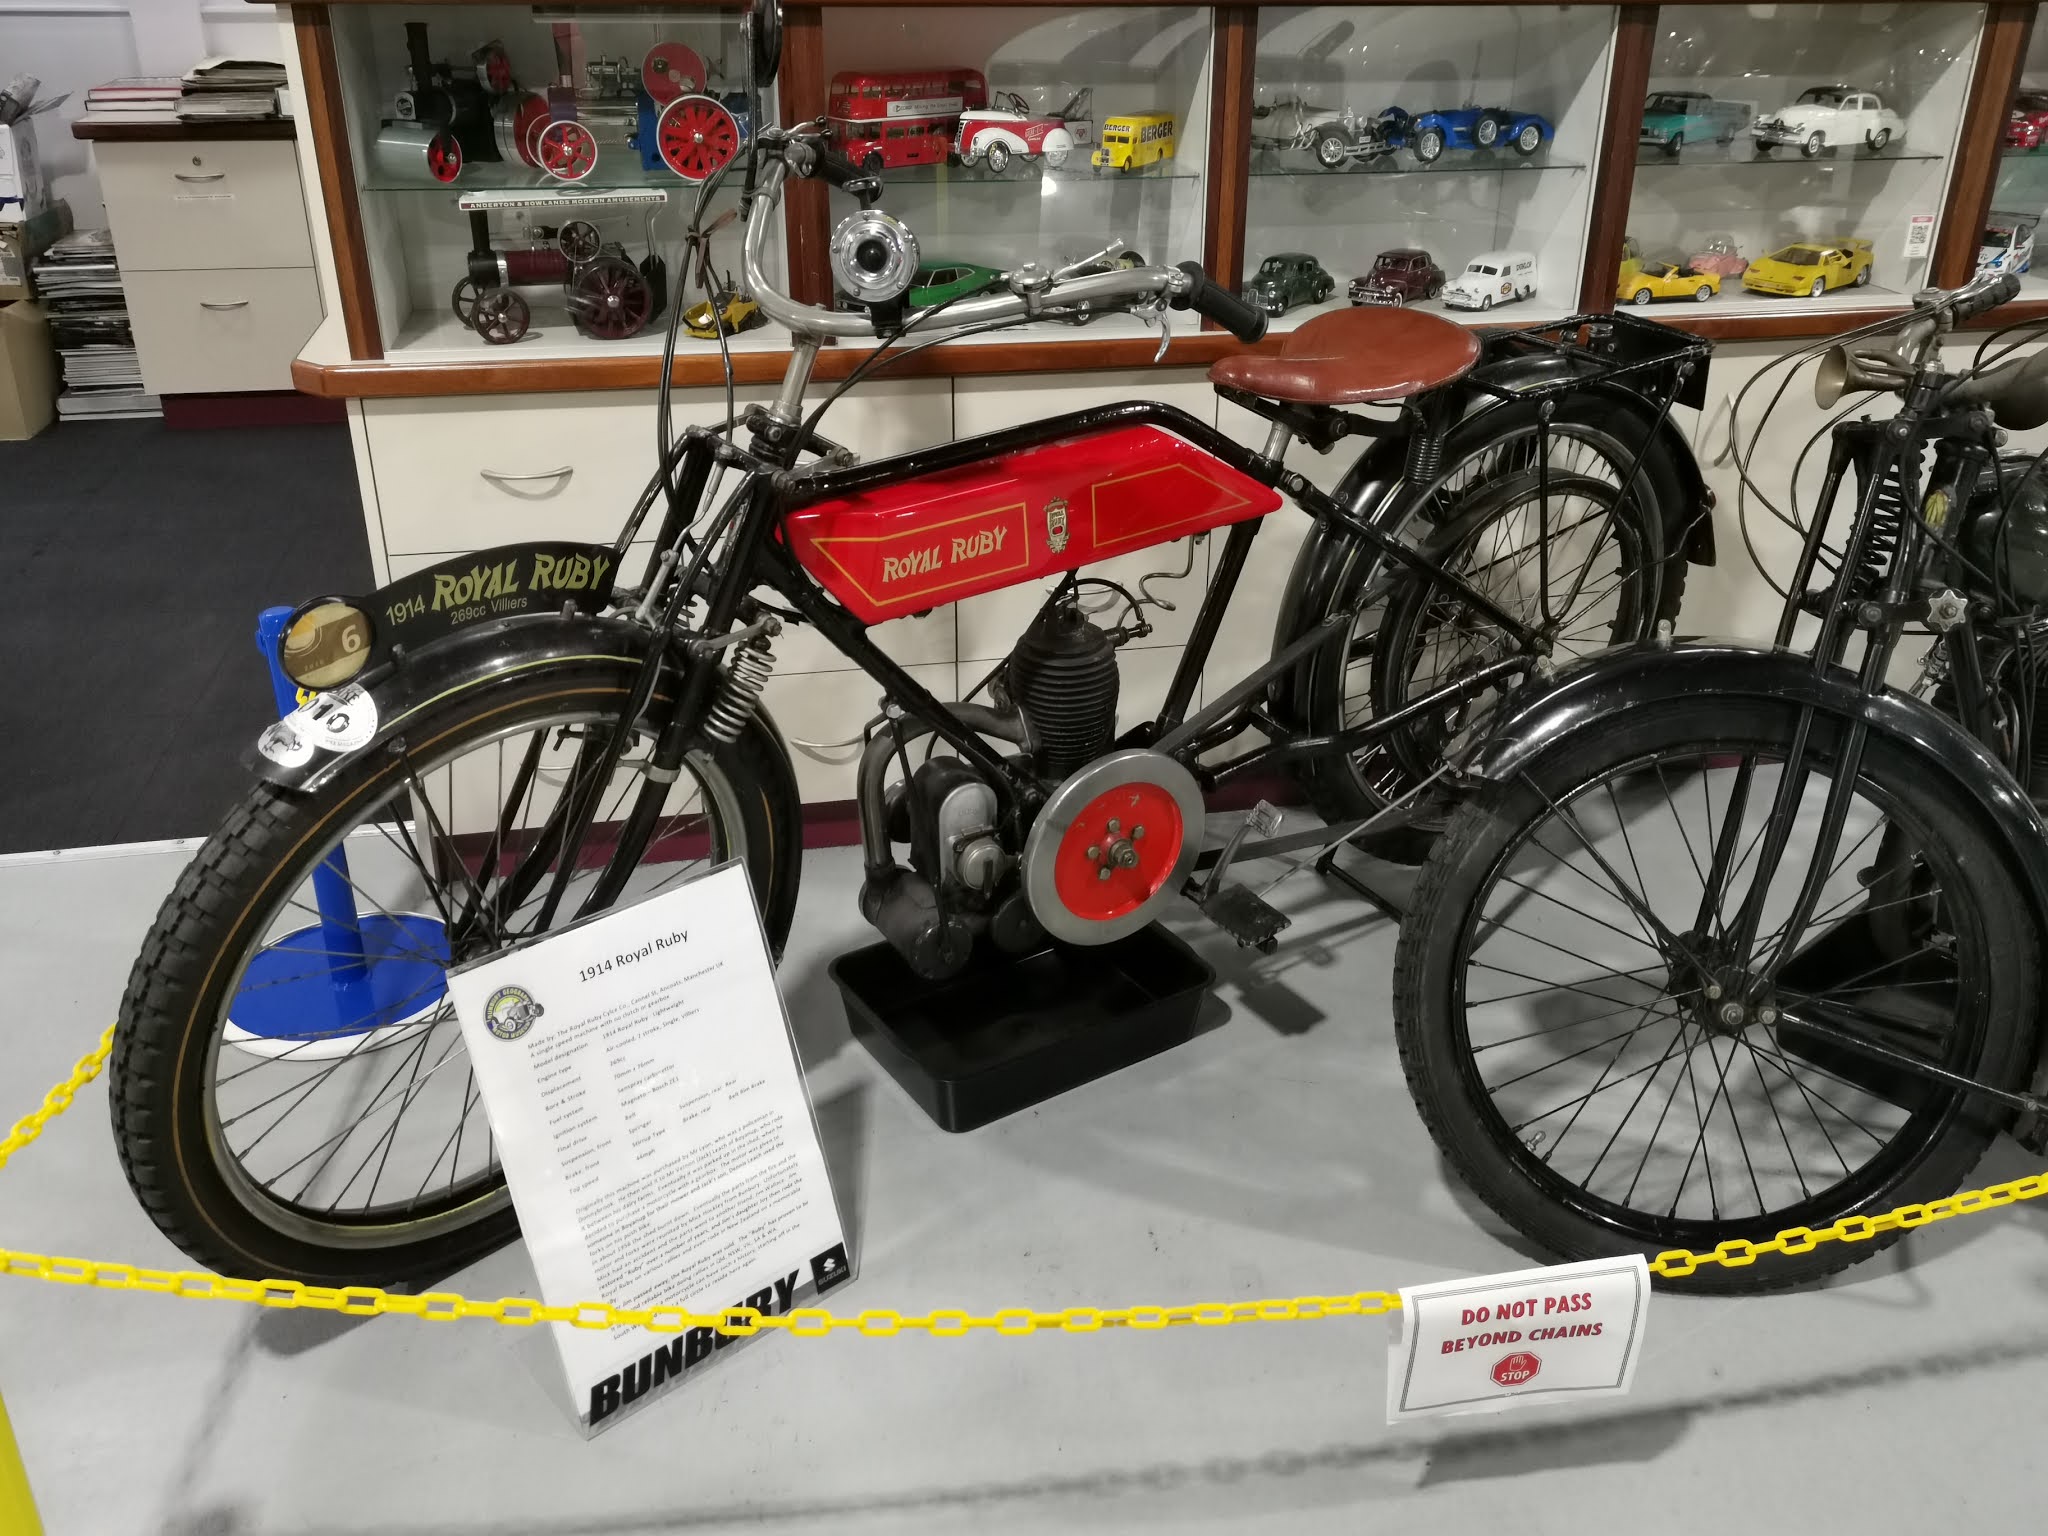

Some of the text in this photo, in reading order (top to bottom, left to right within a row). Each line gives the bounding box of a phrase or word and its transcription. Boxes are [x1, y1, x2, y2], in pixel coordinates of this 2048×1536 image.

[1104, 123, 1131, 132] BERGER
[1141, 121, 1174, 143] BERGER
[470, 201, 515, 209] ANDERTON
[571, 197, 605, 205] MODERN
[606, 195, 661, 203] AMUSEMENTS
[882, 525, 1008, 583] ROYAL RUBY
[385, 552, 611, 627] 1914 ROYAL RUBY
[450, 596, 529, 626] 269cc Villiers
[341, 624, 362, 654] 6
[579, 930, 688, 983] 1914 Royal Ruby
[818, 1265, 847, 1286] SUZUKI
[1461, 1292, 1592, 1326] DO NOT PASS
[590, 1268, 800, 1427] BUNBURY
[1441, 1322, 1603, 1355] BEYOND CHAINS
[1500, 1369, 1530, 1382] STOP
